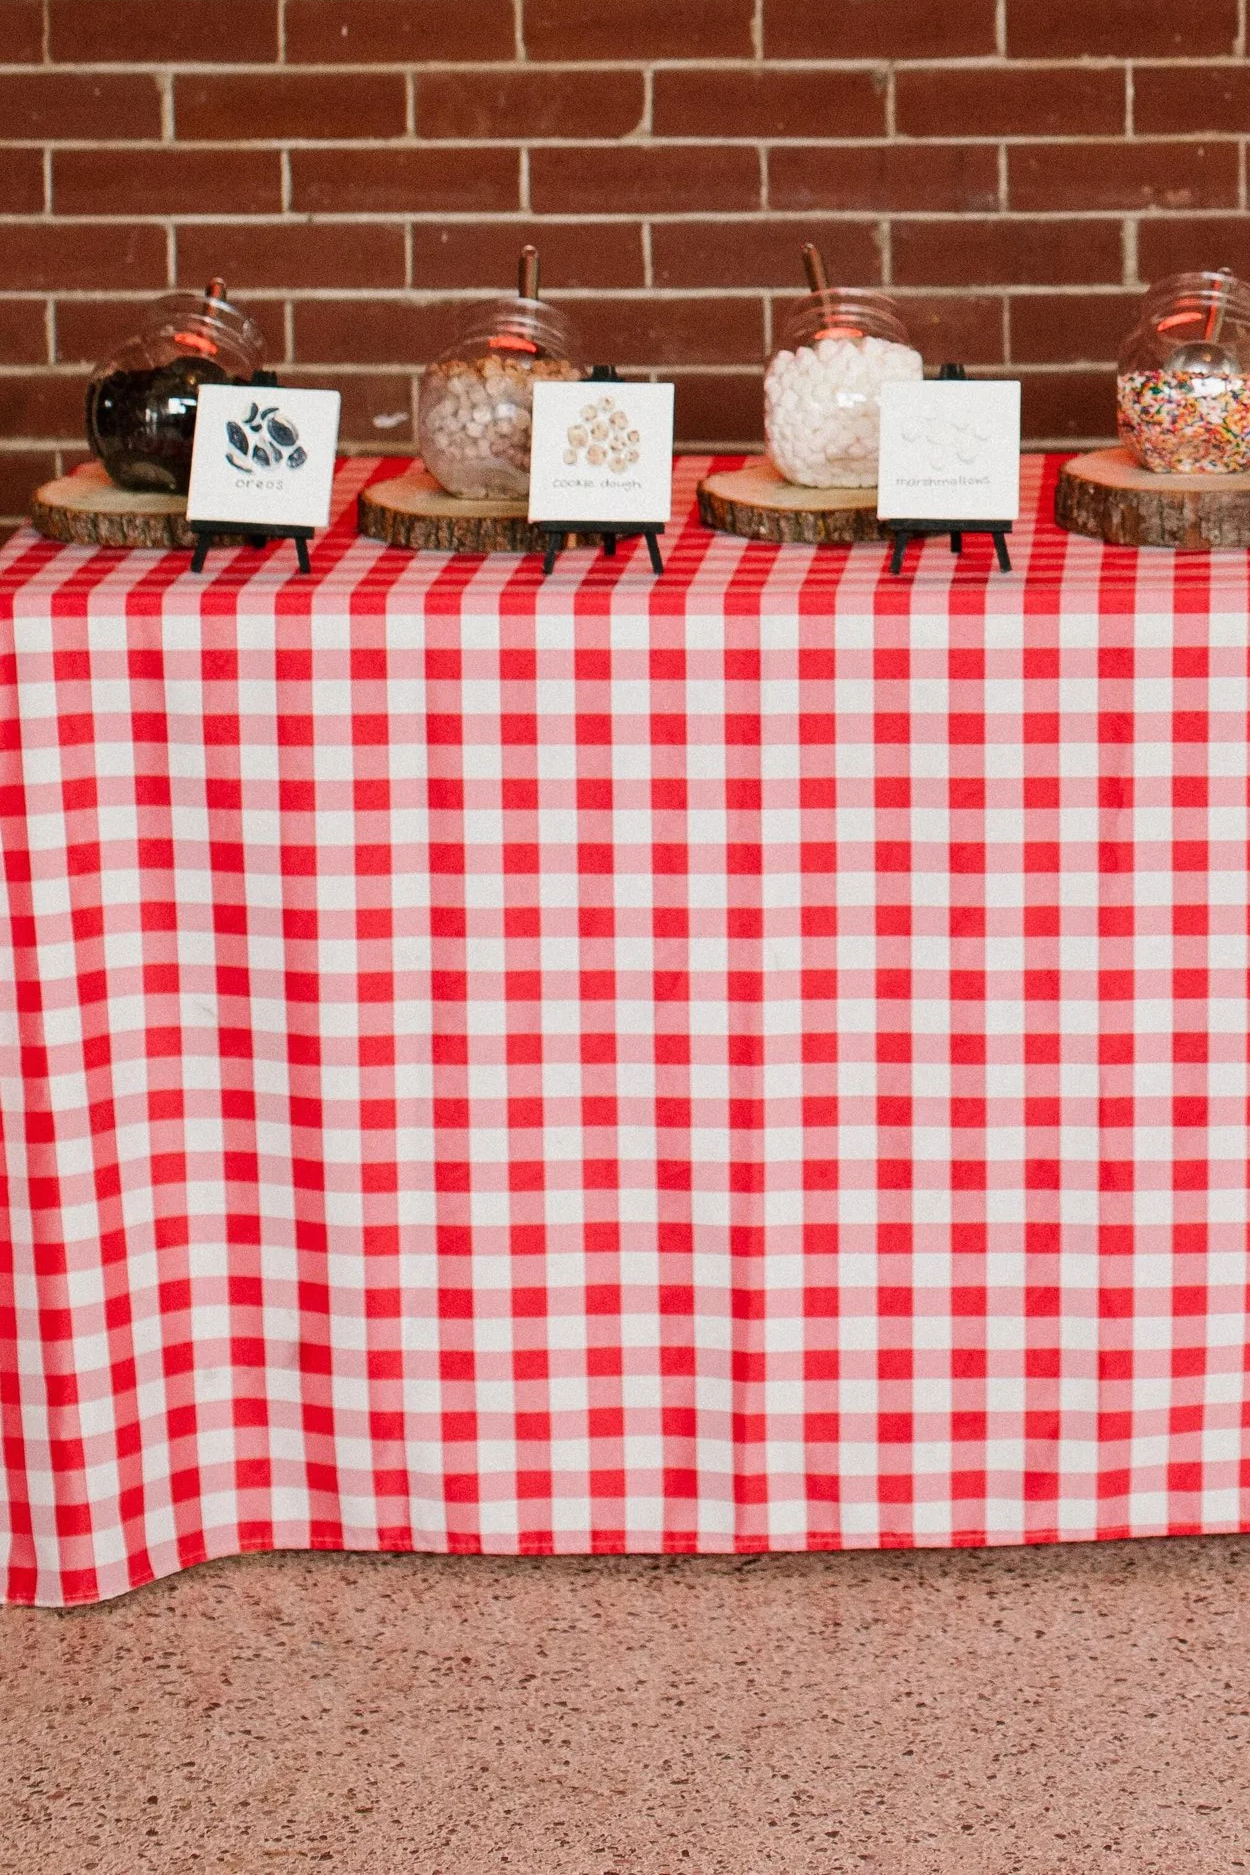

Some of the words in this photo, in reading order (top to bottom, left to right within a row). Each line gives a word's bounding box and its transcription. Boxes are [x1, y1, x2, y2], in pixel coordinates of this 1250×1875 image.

[234, 478, 284, 491] oreos
[552, 478, 594, 488] cookie
[600, 478, 642, 492] dough
